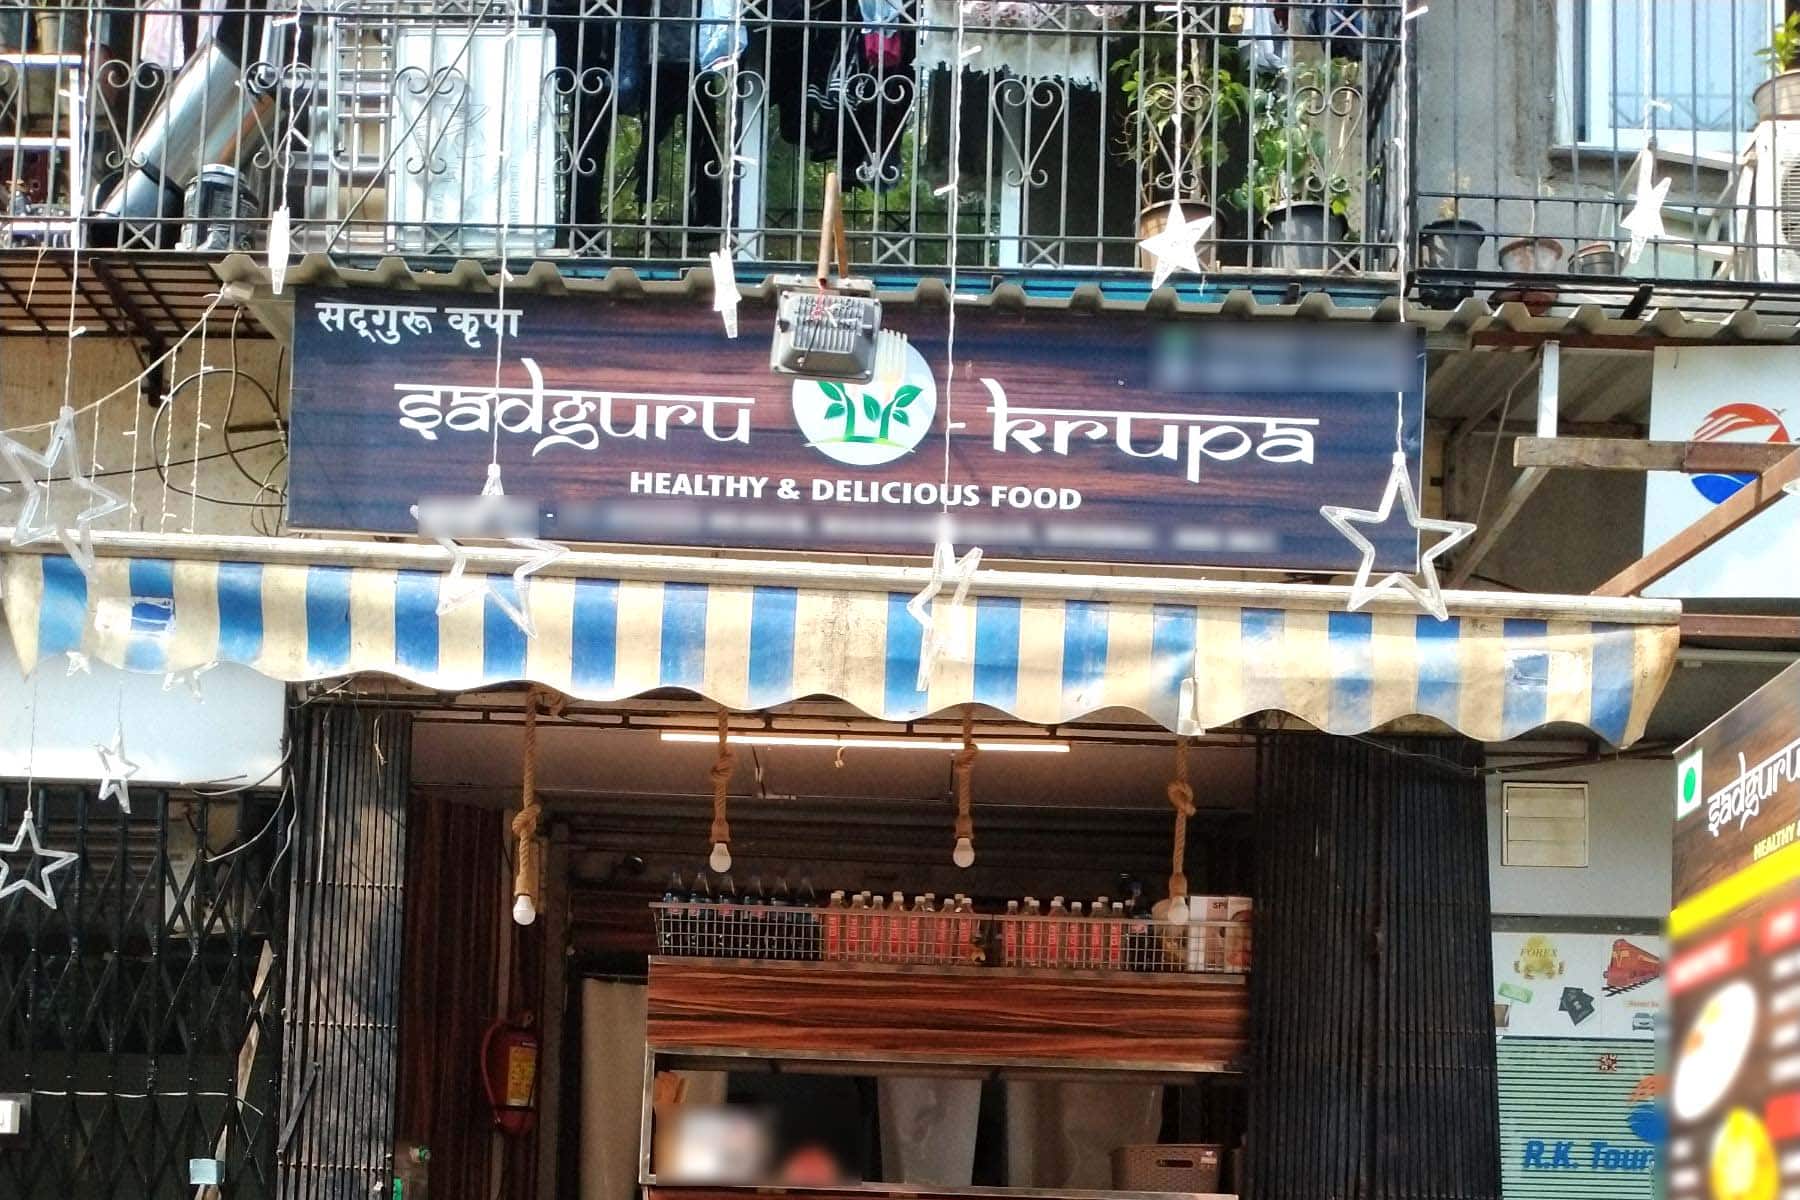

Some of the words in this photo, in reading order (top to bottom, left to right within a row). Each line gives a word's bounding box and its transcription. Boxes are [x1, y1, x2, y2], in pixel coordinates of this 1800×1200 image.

[444, 307, 523, 348] कृपा
[394, 358, 755, 457] sadguru
[980, 378, 1320, 483] krupa
[630, 471, 769, 499] HEALTHY
[776, 478, 801, 500] &
[811, 478, 980, 506] DELICIOUS
[991, 485, 1082, 510] FOOD
[1754, 822, 1796, 861] HEALTHY
[1522, 1140, 1578, 1169] R.K.
